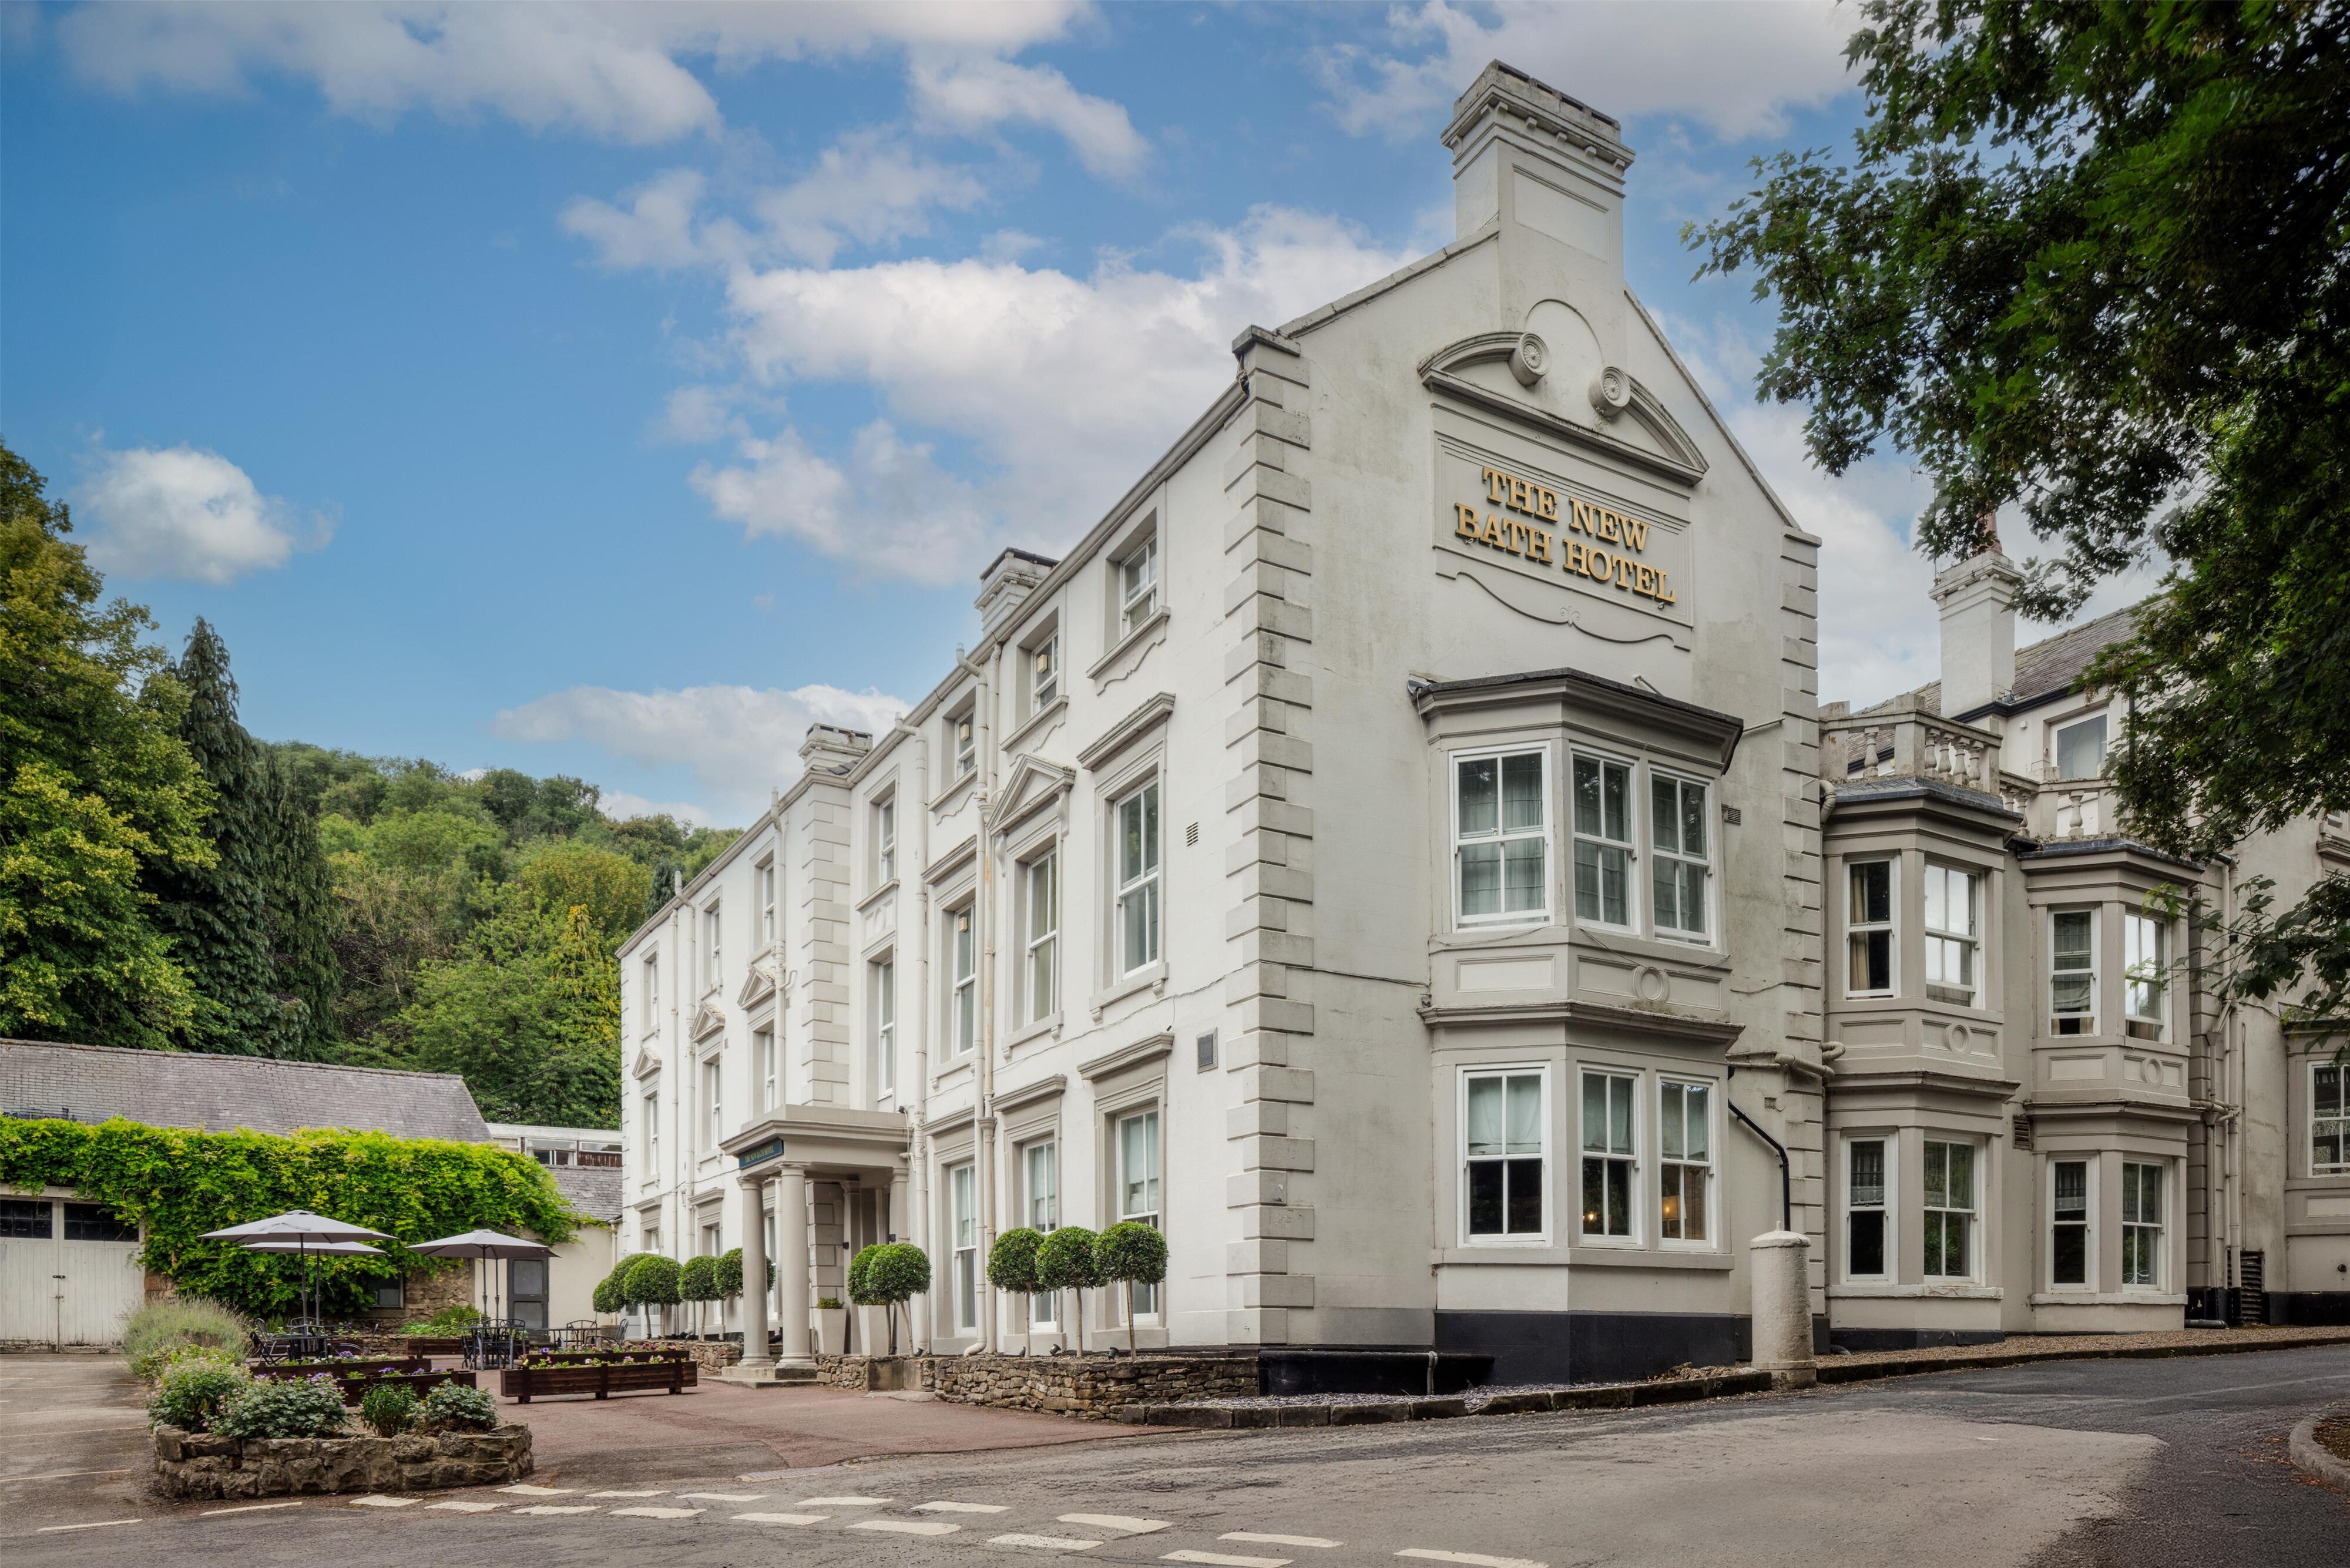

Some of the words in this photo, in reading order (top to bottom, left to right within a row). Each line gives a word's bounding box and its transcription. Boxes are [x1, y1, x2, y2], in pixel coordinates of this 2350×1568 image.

[1454, 502, 1553, 564] BATH
[1563, 538, 1676, 604] HOTEL
[1482, 466, 1559, 522] THE
[1569, 496, 1650, 552] NEW
